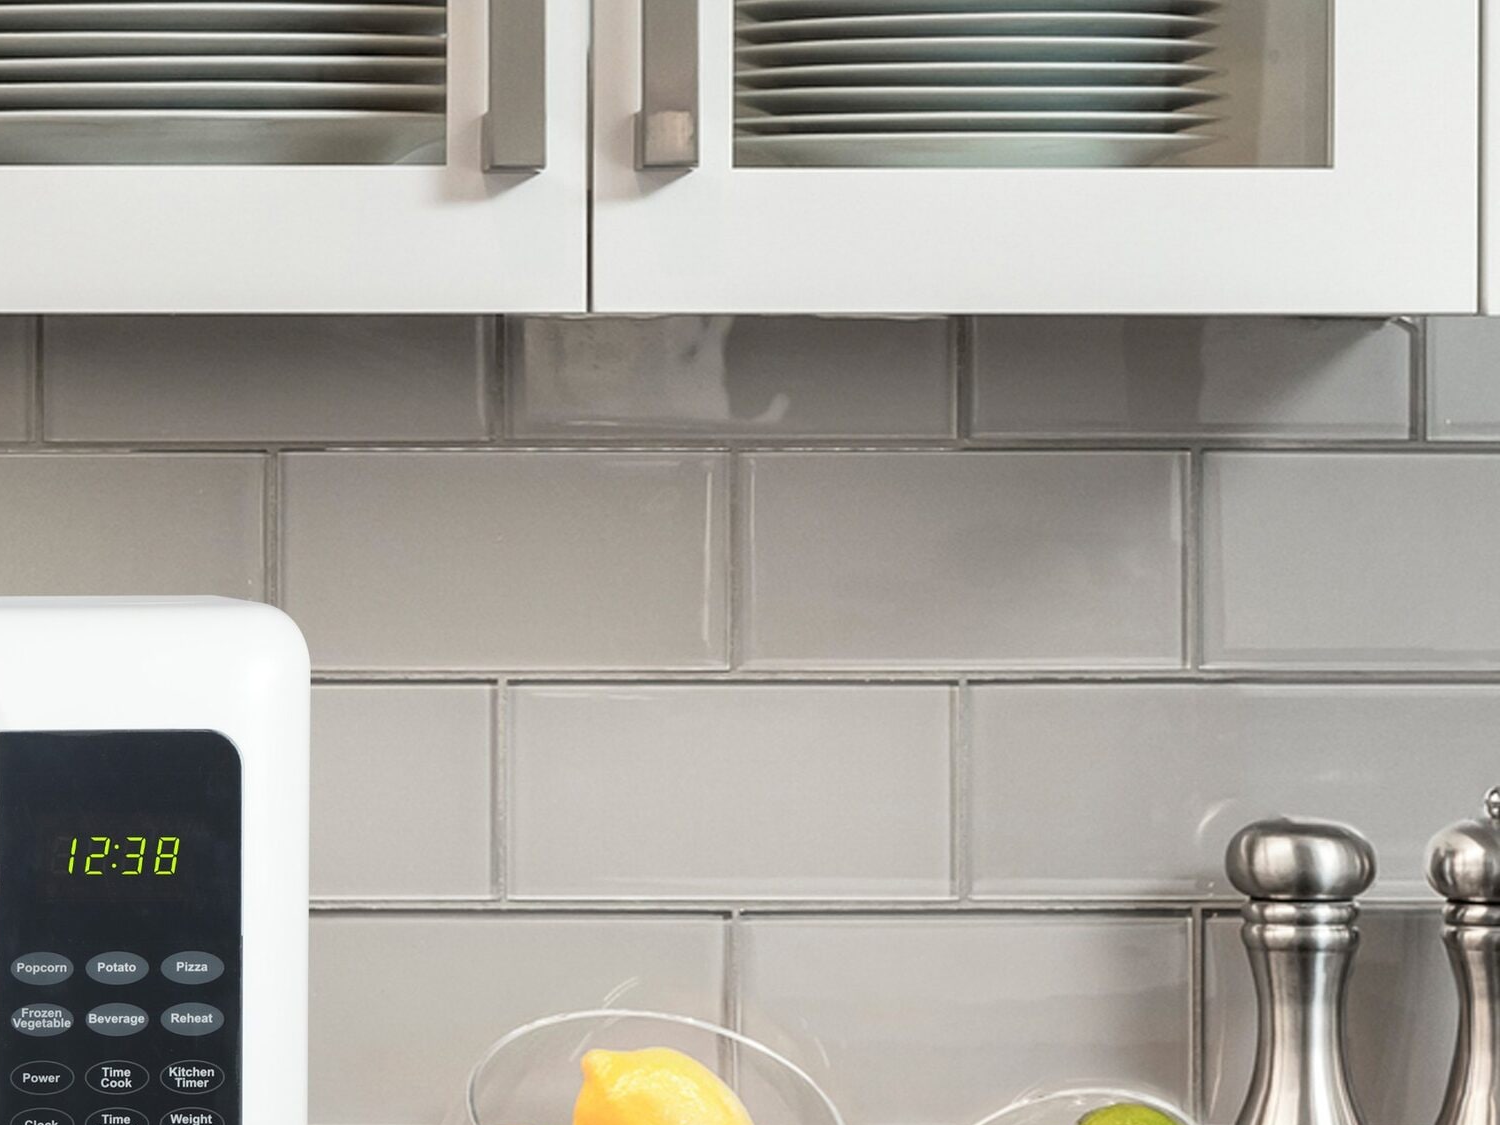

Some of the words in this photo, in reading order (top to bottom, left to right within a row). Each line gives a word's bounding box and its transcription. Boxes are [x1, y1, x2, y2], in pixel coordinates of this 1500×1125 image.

[68, 836, 180, 875] 12:38
[16, 962, 68, 975] Popcorn
[97, 961, 137, 973] Potato
[176, 961, 208, 972] Pizza
[21, 1007, 63, 1019] Frozen
[170, 1012, 214, 1024] Reheat
[12, 1017, 72, 1031] Vegetable
[88, 1013, 145, 1027] Beverage
[22, 1072, 61, 1083] Power
[101, 1066, 132, 1078] Time
[168, 1066, 215, 1078] Kitchen
[100, 1077, 133, 1089] Cook
[174, 1077, 210, 1088] Timer
[101, 1113, 131, 1125] Time
